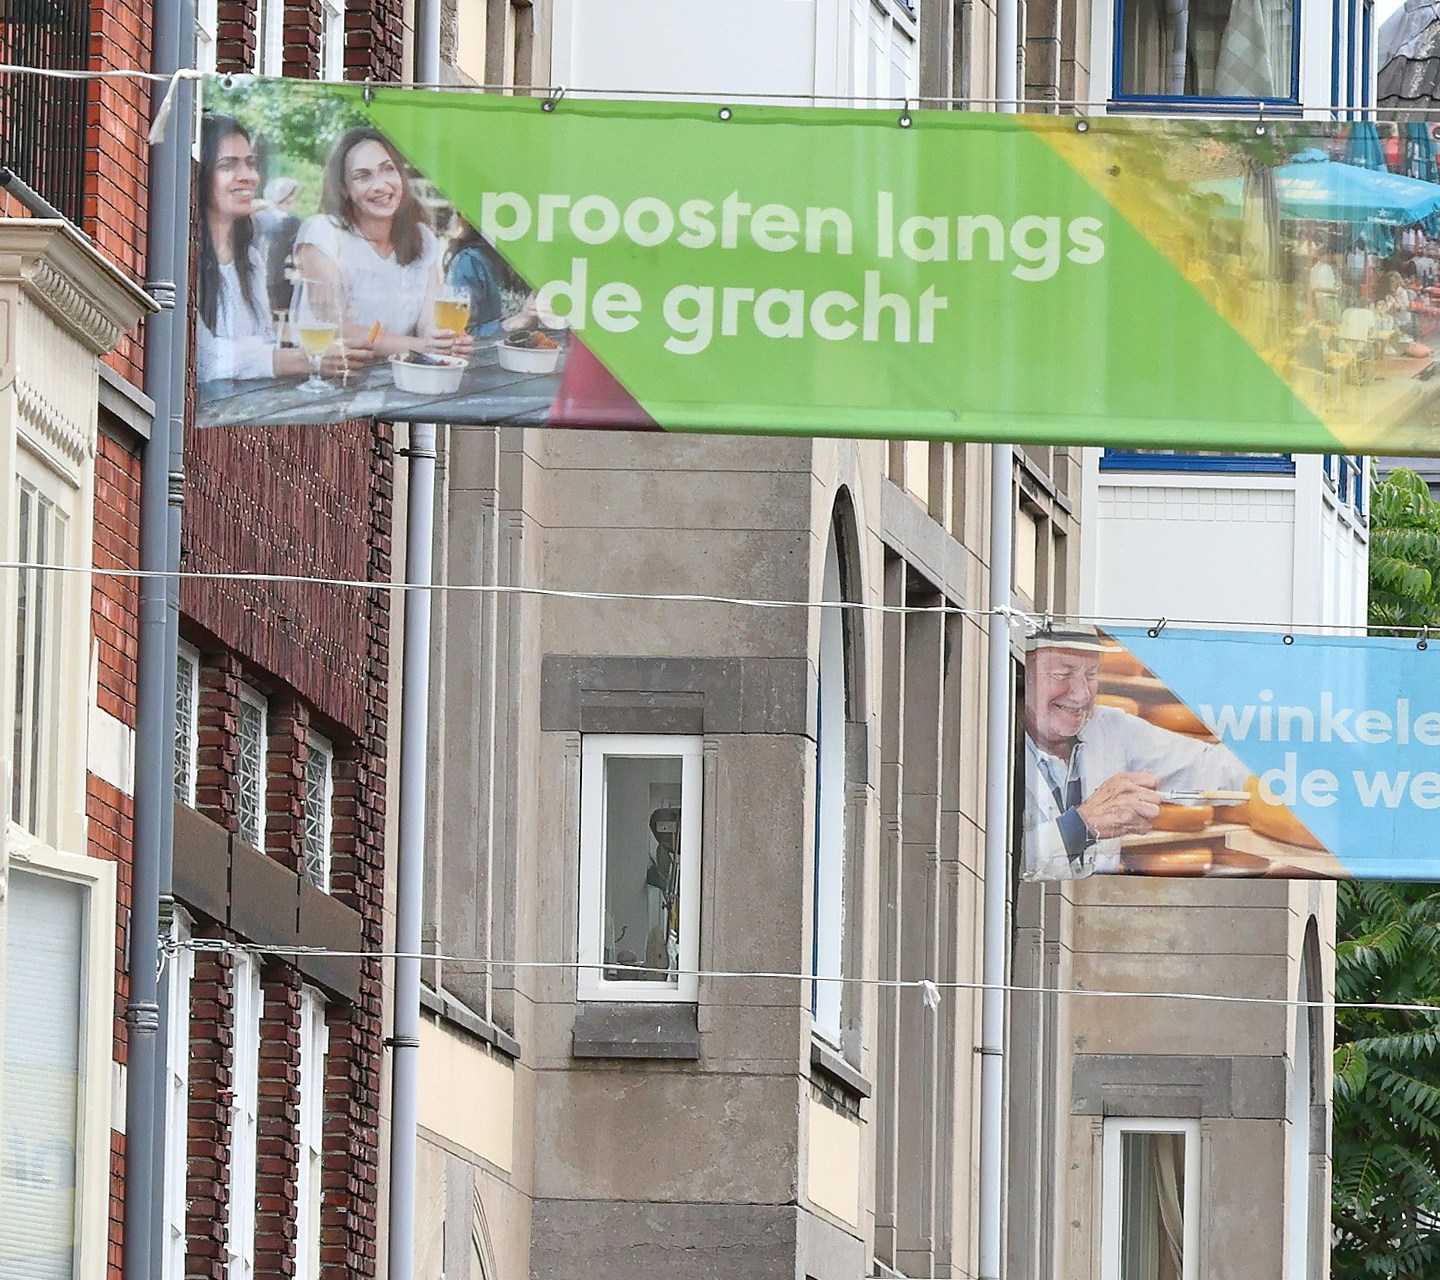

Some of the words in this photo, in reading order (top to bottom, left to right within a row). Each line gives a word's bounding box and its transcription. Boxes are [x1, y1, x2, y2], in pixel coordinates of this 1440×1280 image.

[480, 188, 853, 256] proosten
[876, 190, 1106, 283] langs
[537, 257, 642, 331] de
[663, 263, 949, 355] gracht
[1258, 752, 1340, 808] de
